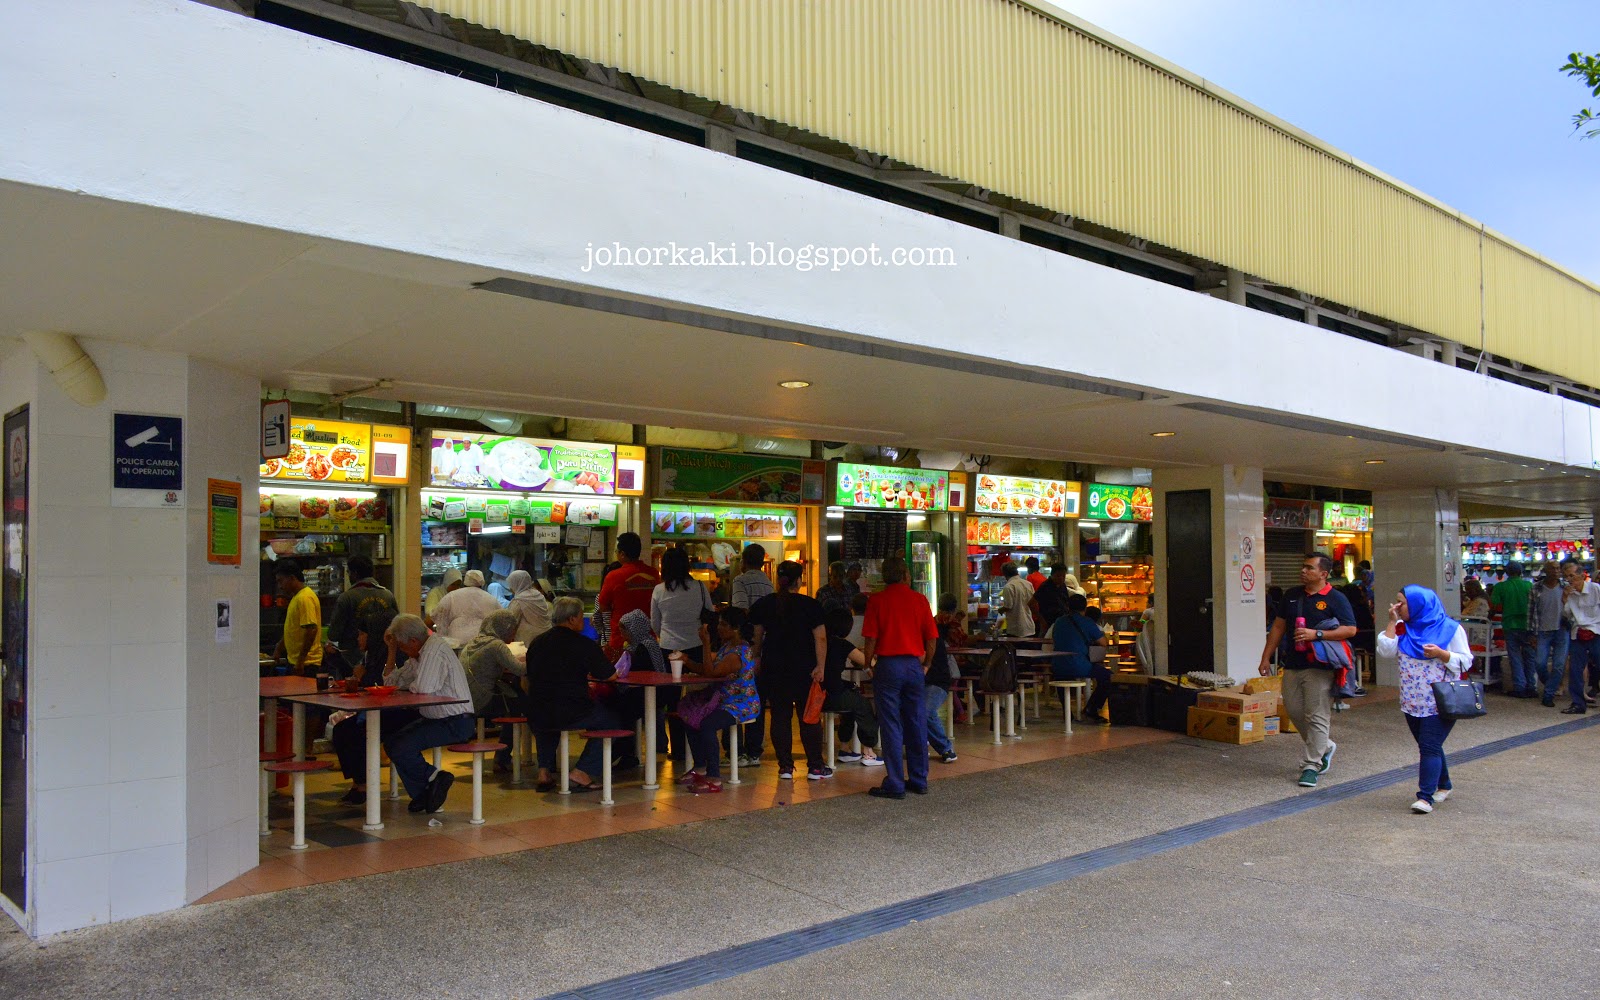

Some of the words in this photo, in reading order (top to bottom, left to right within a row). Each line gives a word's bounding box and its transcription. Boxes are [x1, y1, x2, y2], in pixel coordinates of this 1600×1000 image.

[305, 430, 337, 443] Muslim
[340, 436, 361, 446] Food
[554, 449, 582, 458] Traditional
[116, 457, 144, 466] POLICE
[145, 459, 180, 467] CAMERA
[579, 458, 609, 475] Piring
[131, 467, 175, 476] OPERATION
